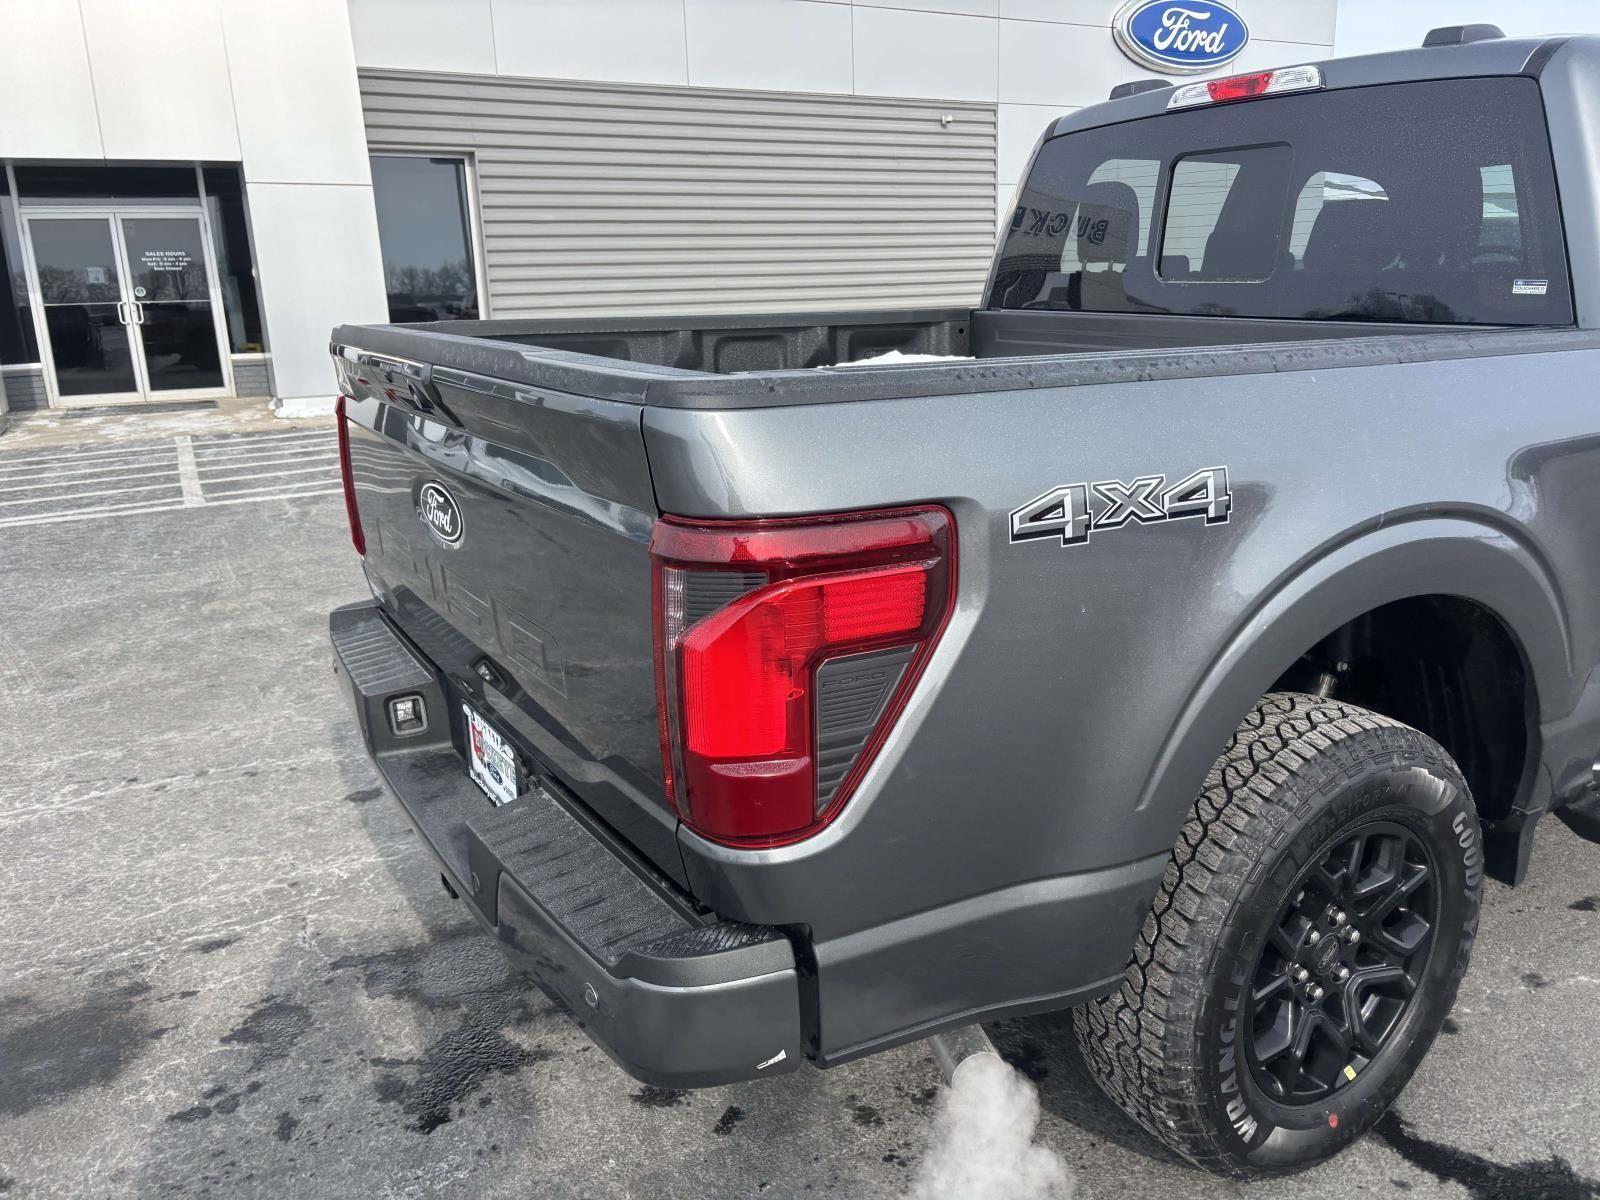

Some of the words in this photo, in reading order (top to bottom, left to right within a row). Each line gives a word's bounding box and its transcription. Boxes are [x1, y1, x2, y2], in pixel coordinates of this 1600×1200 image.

[1153, 7, 1228, 54] Ford
[427, 489, 452, 533] Ford
[822, 671, 889, 691] FORD
